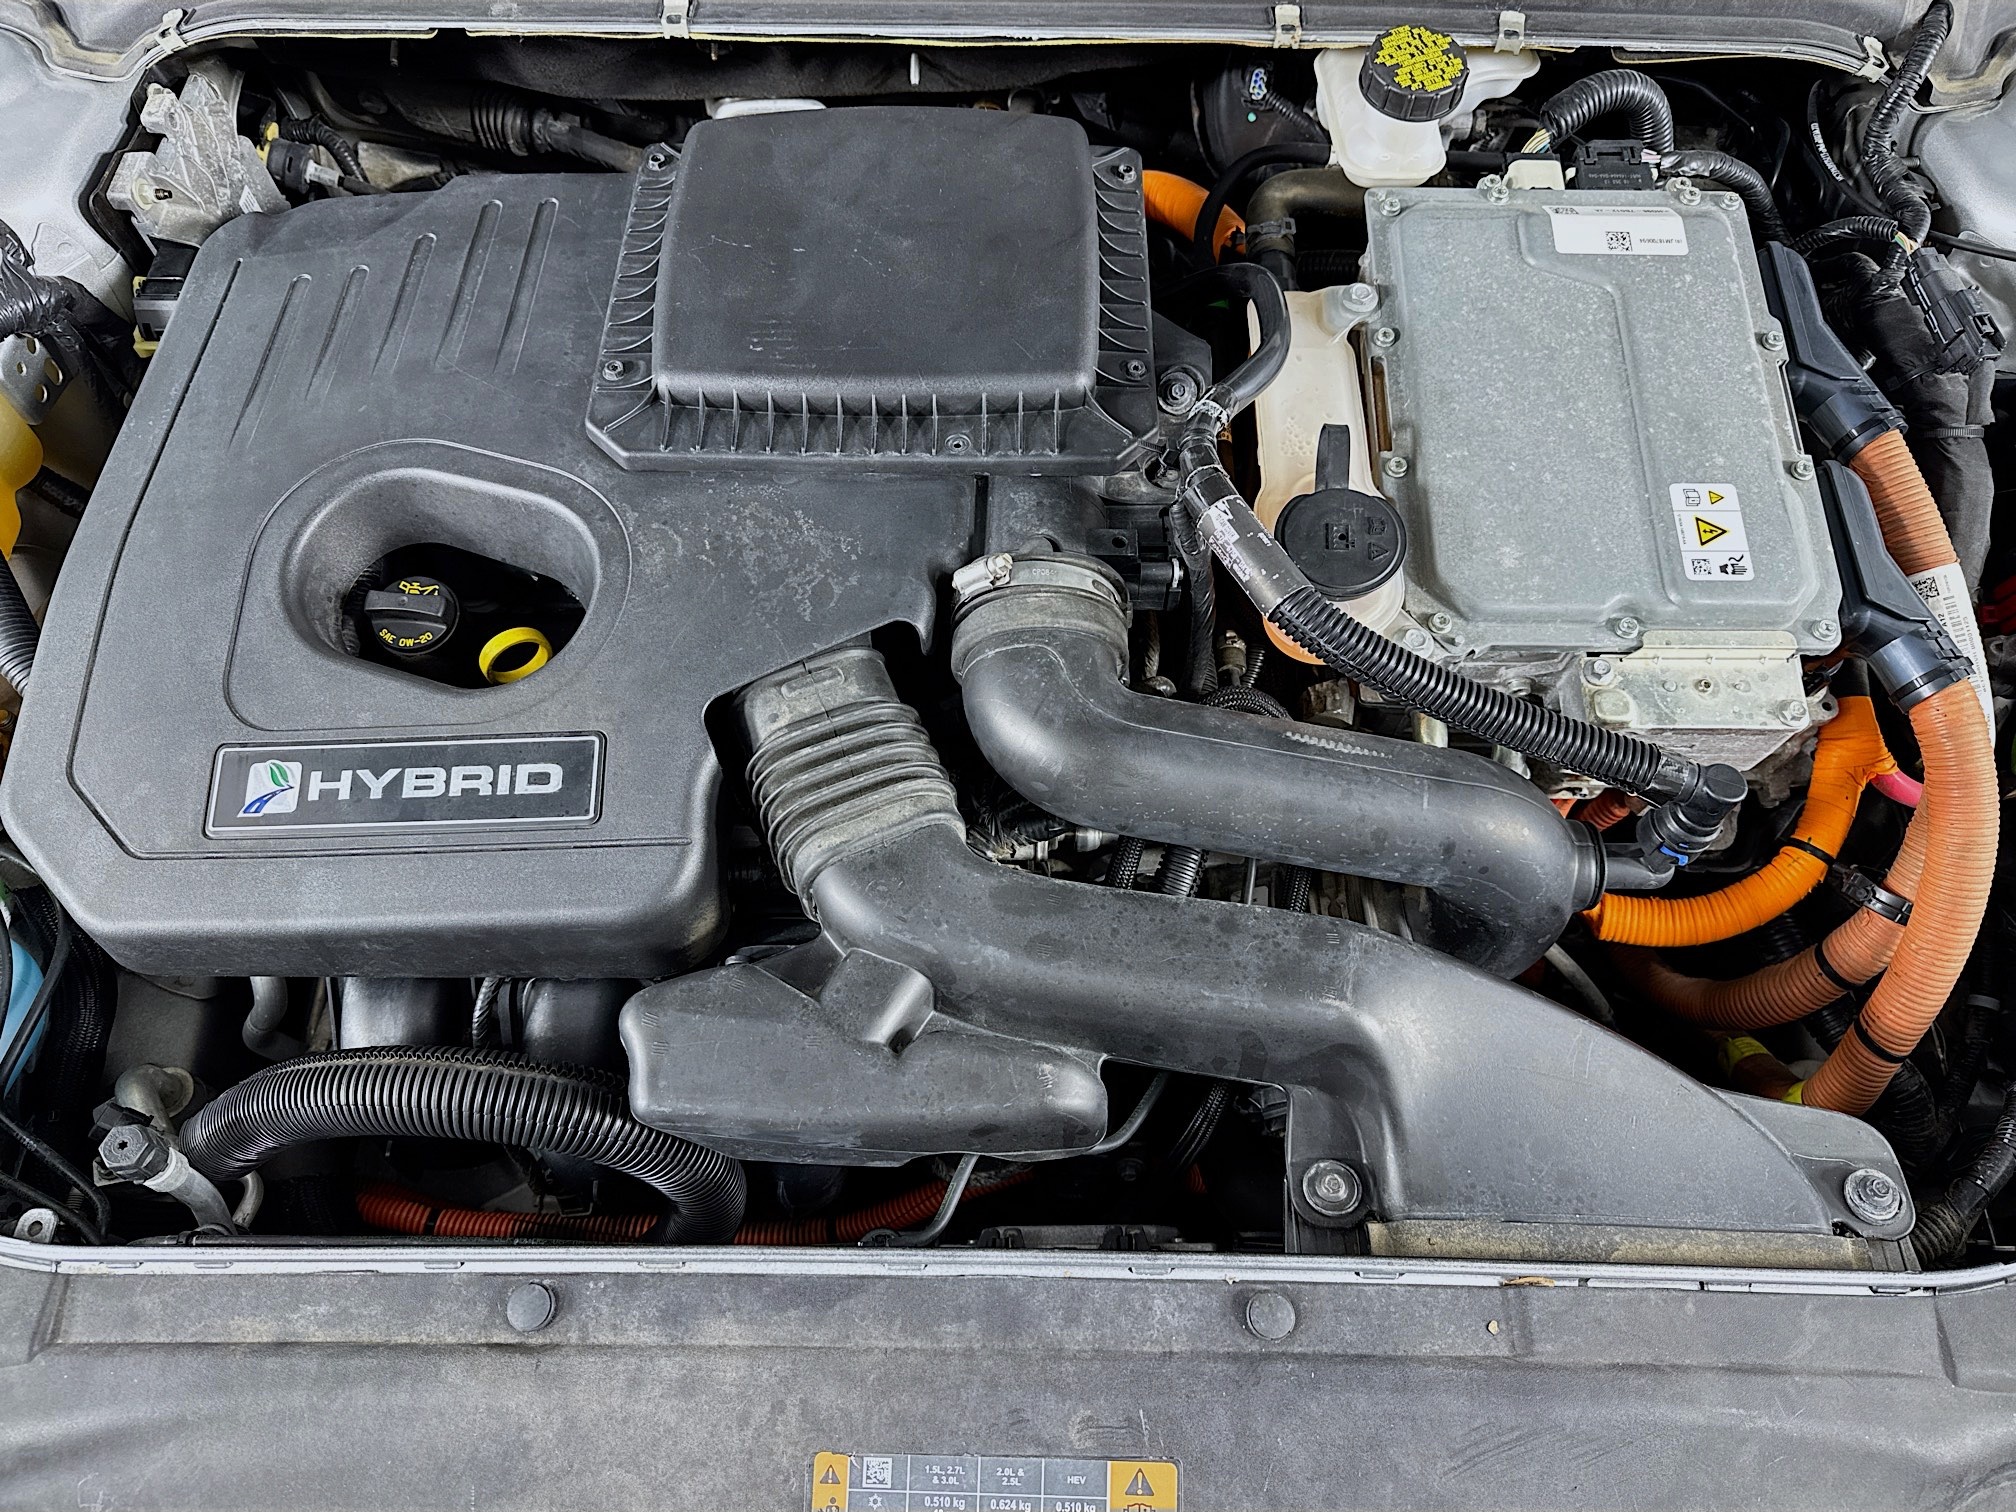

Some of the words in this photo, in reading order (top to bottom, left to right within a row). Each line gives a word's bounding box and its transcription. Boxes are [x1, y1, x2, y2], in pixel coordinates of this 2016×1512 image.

[1938, 613, 1948, 627] A12
[379, 628, 397, 644] SAE
[399, 632, 433, 647] 0W-20
[307, 763, 564, 802] HYBRID
[925, 1465, 945, 1475] 1.5L,
[947, 1466, 965, 1475] 2.7L
[996, 1468, 1016, 1477] 2.0L
[1017, 1468, 1025, 1477] &
[941, 1477, 959, 1485] 3.0L
[1002, 1478, 1022, 1486] 2.5L
[1067, 1476, 1087, 1485] HEV
[924, 1496, 949, 1507] 0.510
[952, 1497, 966, 1510] kg
[990, 1499, 1016, 1511] 0.624
[1018, 1500, 1032, 1512] kg
[1056, 1502, 1081, 1512] 0.510
[1084, 1502, 1096, 1512] kg
